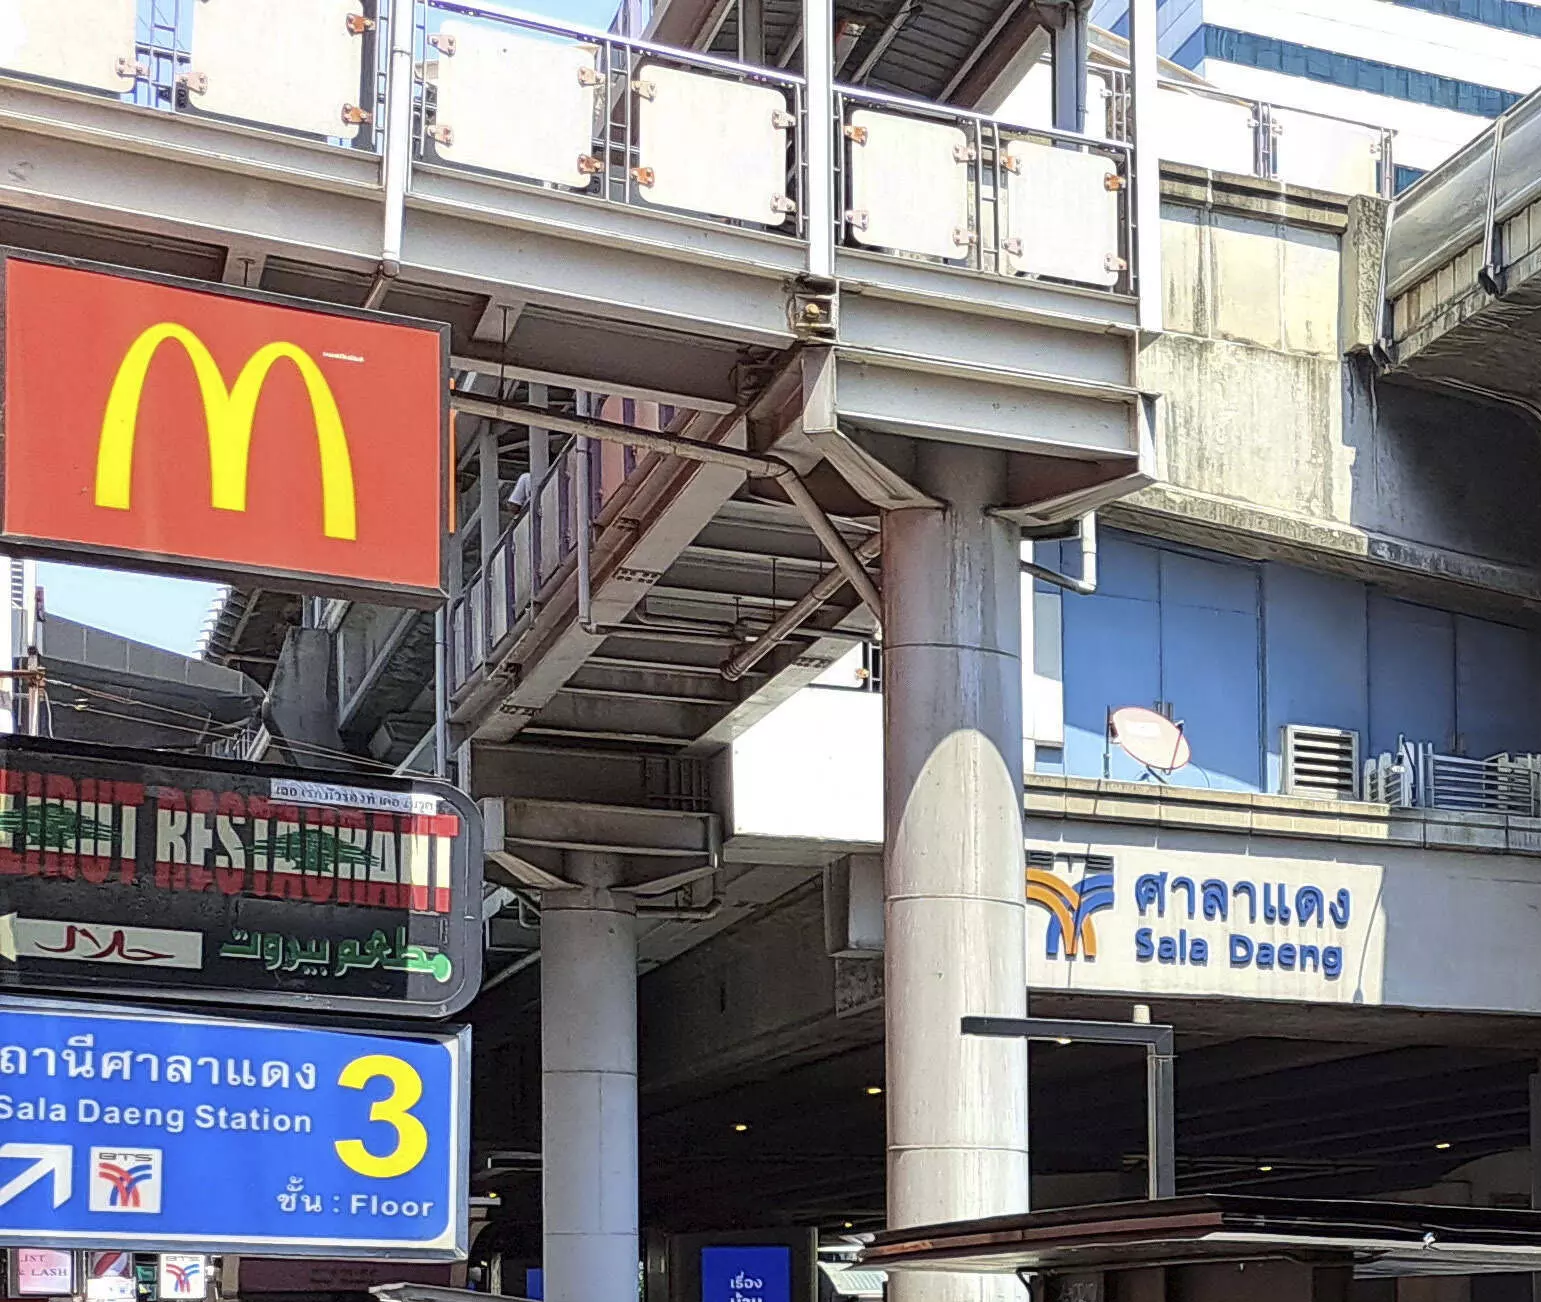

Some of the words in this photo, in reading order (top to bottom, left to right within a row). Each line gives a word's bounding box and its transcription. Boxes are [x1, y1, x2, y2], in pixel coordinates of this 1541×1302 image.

[155, 784, 459, 914] RESTAURANT
[1135, 871, 1351, 928] ศาลาแดง
[35, 924, 176, 962] حلال
[1135, 928, 1208, 966] Sala
[1229, 933, 1343, 980] Daeng
[78, 1098, 184, 1134] Daeng
[194, 1105, 312, 1133] Station
[335, 1054, 429, 1179] 3
[276, 1177, 323, 1214] ชั้น
[350, 1194, 435, 1217] Floor
[31, 1269, 68, 1277] LASH
[730, 1271, 763, 1289] เรื่อง
